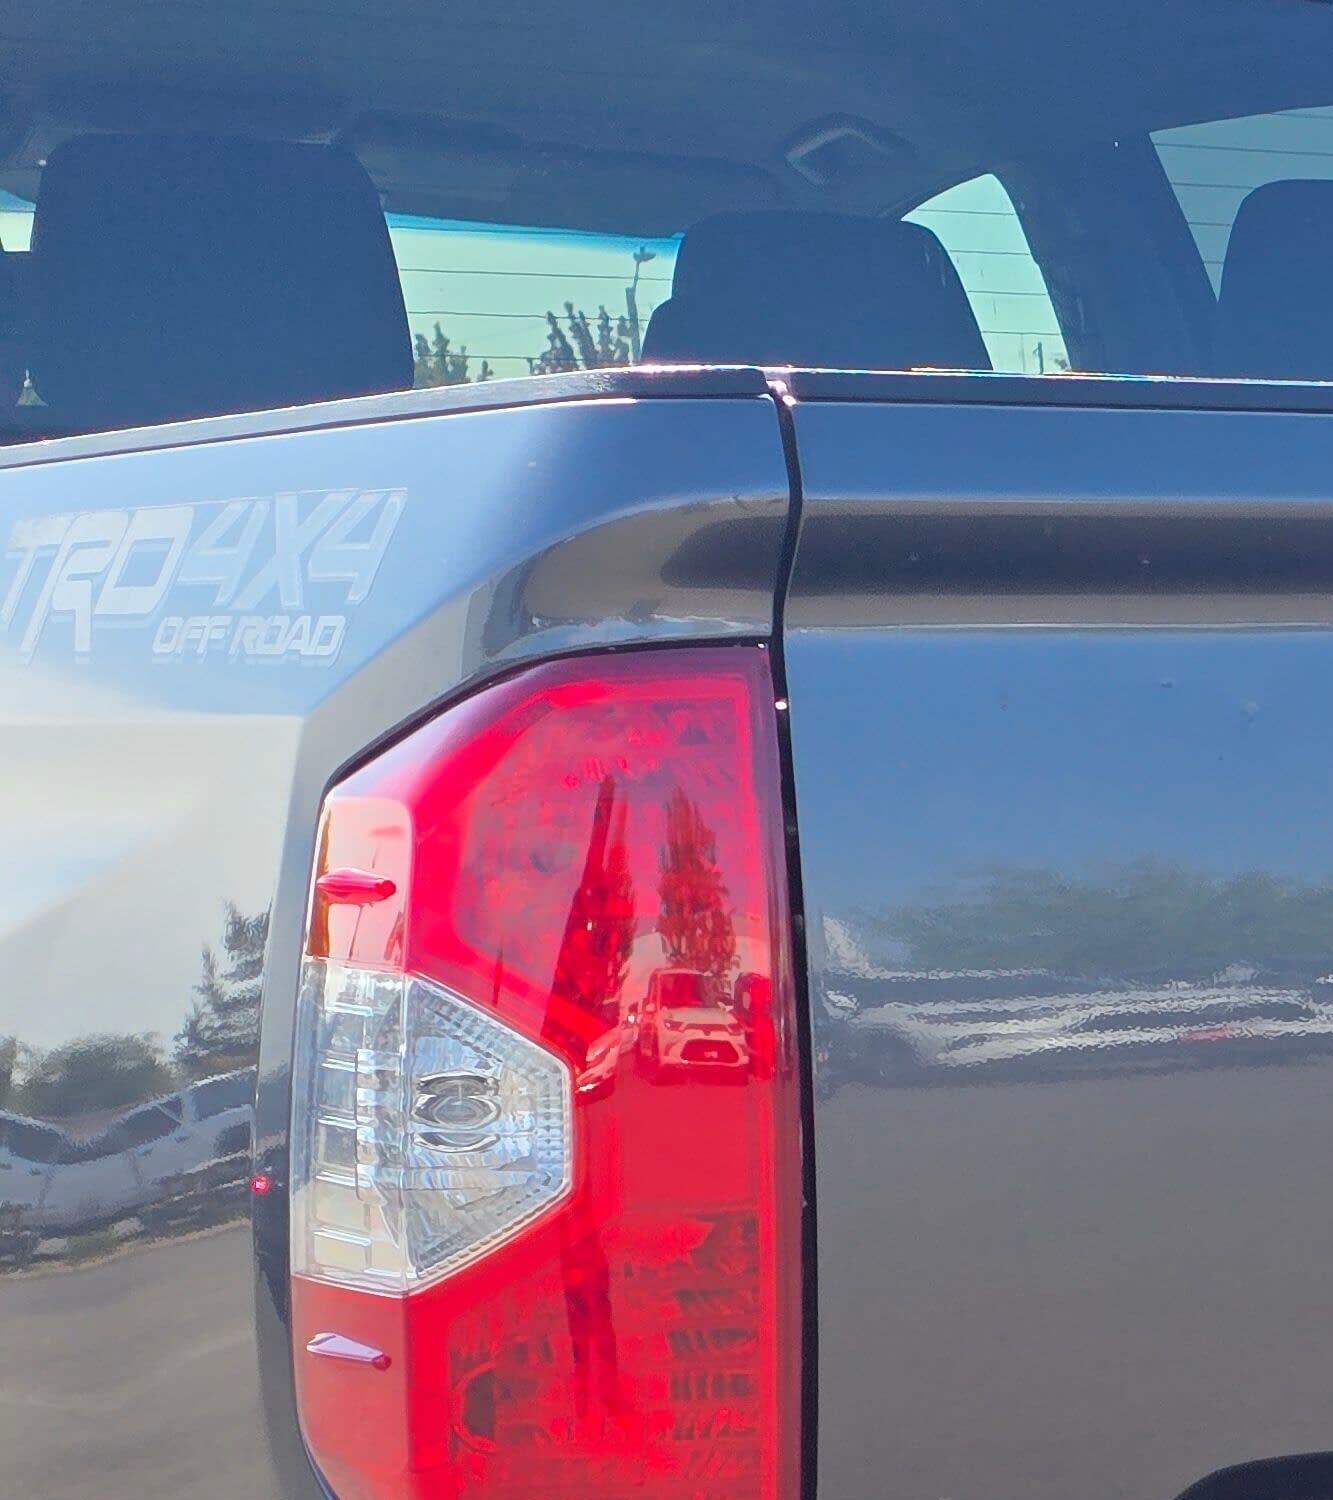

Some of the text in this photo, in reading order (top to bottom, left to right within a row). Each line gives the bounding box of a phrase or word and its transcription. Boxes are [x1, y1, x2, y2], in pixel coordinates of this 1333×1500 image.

[2, 506, 195, 658] TRD
[152, 615, 347, 660] OFF ROAD
